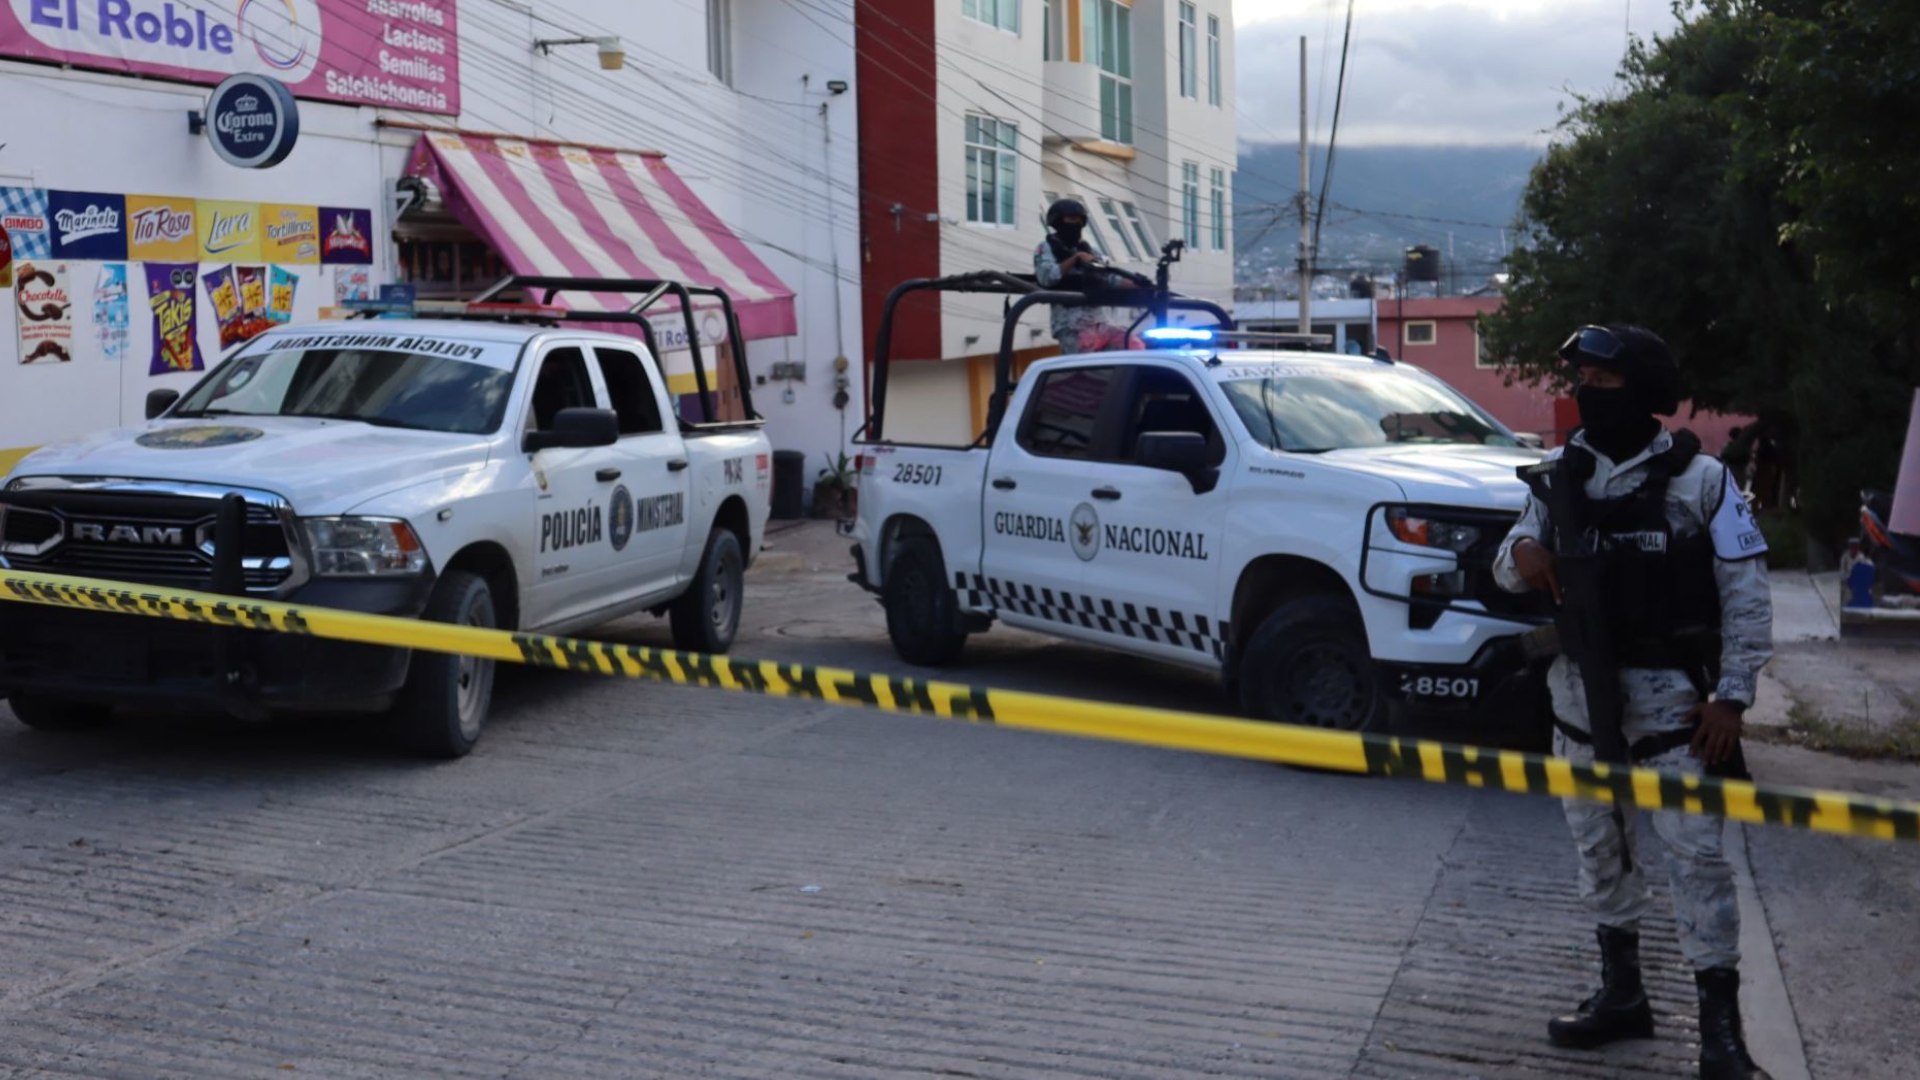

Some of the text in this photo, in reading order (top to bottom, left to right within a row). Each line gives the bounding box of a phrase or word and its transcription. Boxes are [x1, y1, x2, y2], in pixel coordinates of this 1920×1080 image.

[31, 0, 234, 54] El Roble
[379, 50, 446, 82] Semillas
[217, 110, 273, 133] Corona
[234, 129, 264, 143] Extra
[5, 217, 43, 230] BIMBO
[56, 206, 118, 232] Marinela
[155, 209, 191, 238] Rosa
[207, 211, 250, 245] Lara
[155, 298, 192, 339] Takis
[893, 462, 942, 486] 28501
[540, 499, 602, 553] POLICÍA
[636, 492, 684, 533] MINISTERIAL
[994, 512, 1066, 542] GUARDIA
[73, 522, 182, 545] RAM
[1104, 524, 1208, 560] NACIONAL
[1400, 674, 1480, 697] 28501
